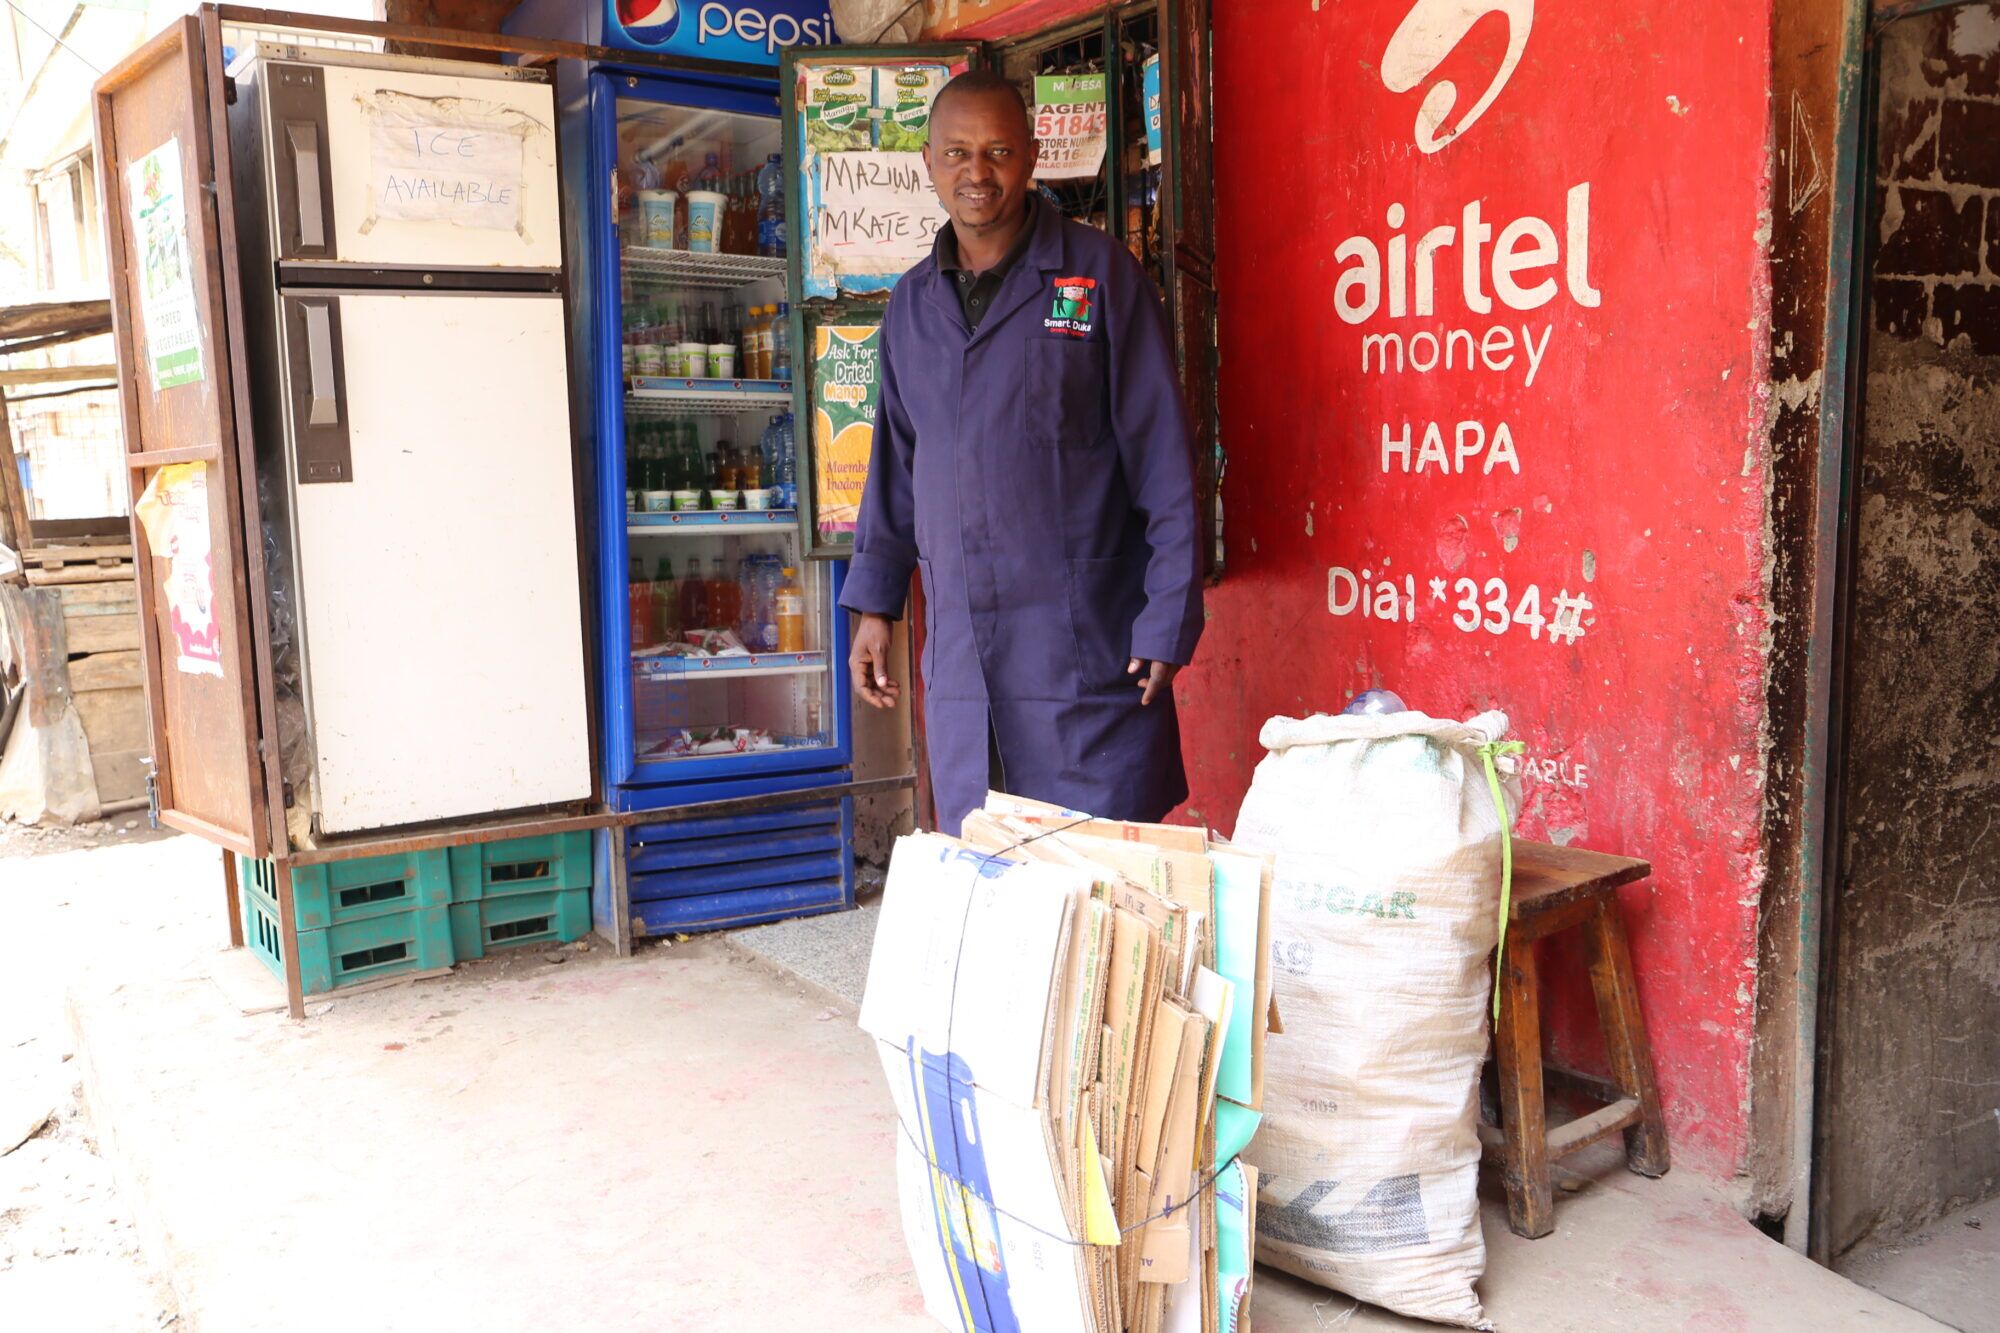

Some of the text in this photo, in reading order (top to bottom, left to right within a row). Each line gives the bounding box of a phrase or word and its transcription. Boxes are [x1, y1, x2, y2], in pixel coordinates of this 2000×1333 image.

[699, 2, 831, 54] pepsi
[1040, 102, 1106, 114] AGENT
[414, 130, 482, 158] ICE
[1040, 138, 1068, 149] STORE
[384, 174, 512, 205] AVAILABLE
[825, 157, 921, 195] MAZIWA
[825, 208, 909, 242] MKATE
[1334, 181, 1601, 325] airtel
[1044, 318, 1071, 328] Smart
[1072, 321, 1091, 332] Duka
[828, 344, 878, 361] Ask For:
[1362, 324, 1552, 387] money
[835, 360, 875, 384] Dried
[823, 381, 867, 409] Mango
[1382, 420, 1520, 475] HAPA
[1327, 566, 1415, 623] Dial
